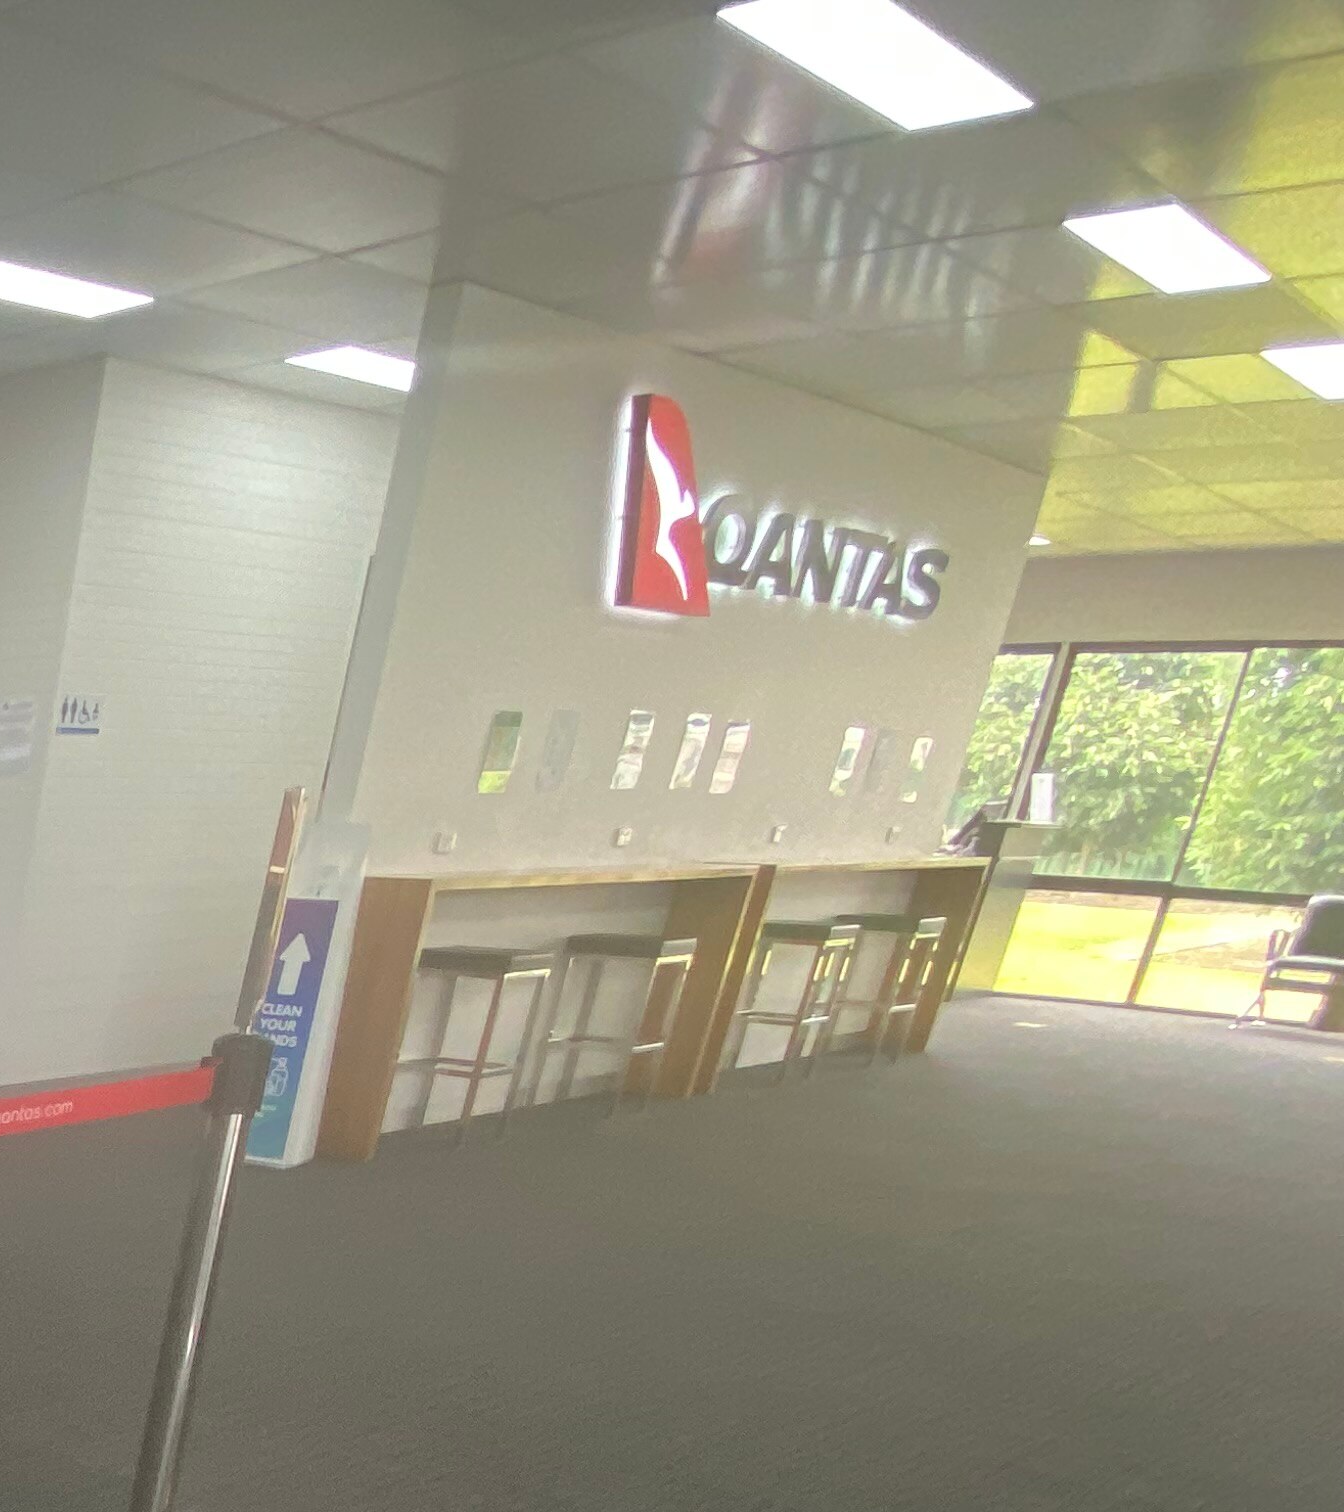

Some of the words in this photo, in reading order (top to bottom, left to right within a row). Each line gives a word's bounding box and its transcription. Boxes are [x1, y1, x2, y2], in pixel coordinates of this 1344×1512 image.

[703, 494, 949, 620] QANTAS
[262, 1003, 302, 1017] CLEAN
[260, 1018, 297, 1032] YOUR
